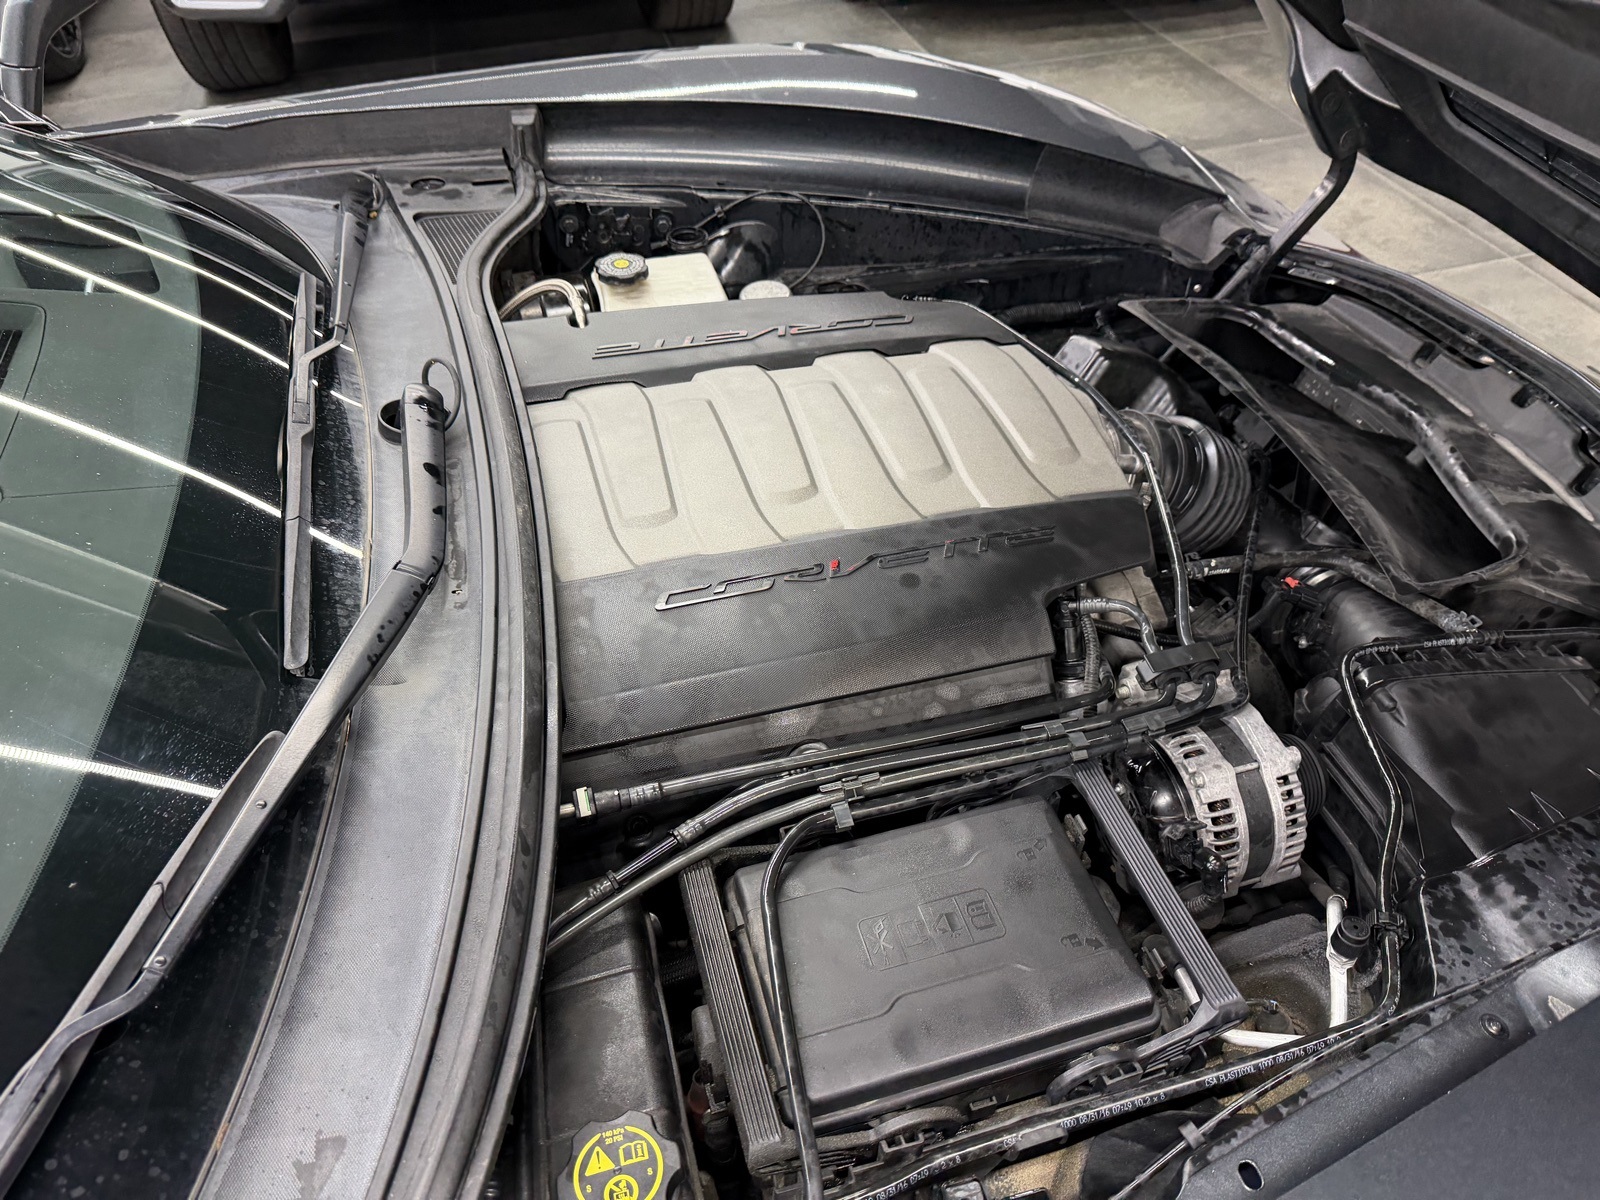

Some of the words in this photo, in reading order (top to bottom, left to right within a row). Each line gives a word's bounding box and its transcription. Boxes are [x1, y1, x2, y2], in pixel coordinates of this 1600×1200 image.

[591, 314, 914, 360] CORVETTE
[654, 525, 1057, 612] CORVETTE
[1205, 1076, 1218, 1087] CSA
[1079, 1107, 1111, 1125] 08/31/16
[1112, 1102, 1132, 1114] 07:49
[1134, 1096, 1151, 1108] 10.2
[1159, 1092, 1166, 1100] 8
[602, 1130, 613, 1138] 140
[604, 1137, 613, 1145] 20
[955, 1155, 962, 1165] 8
